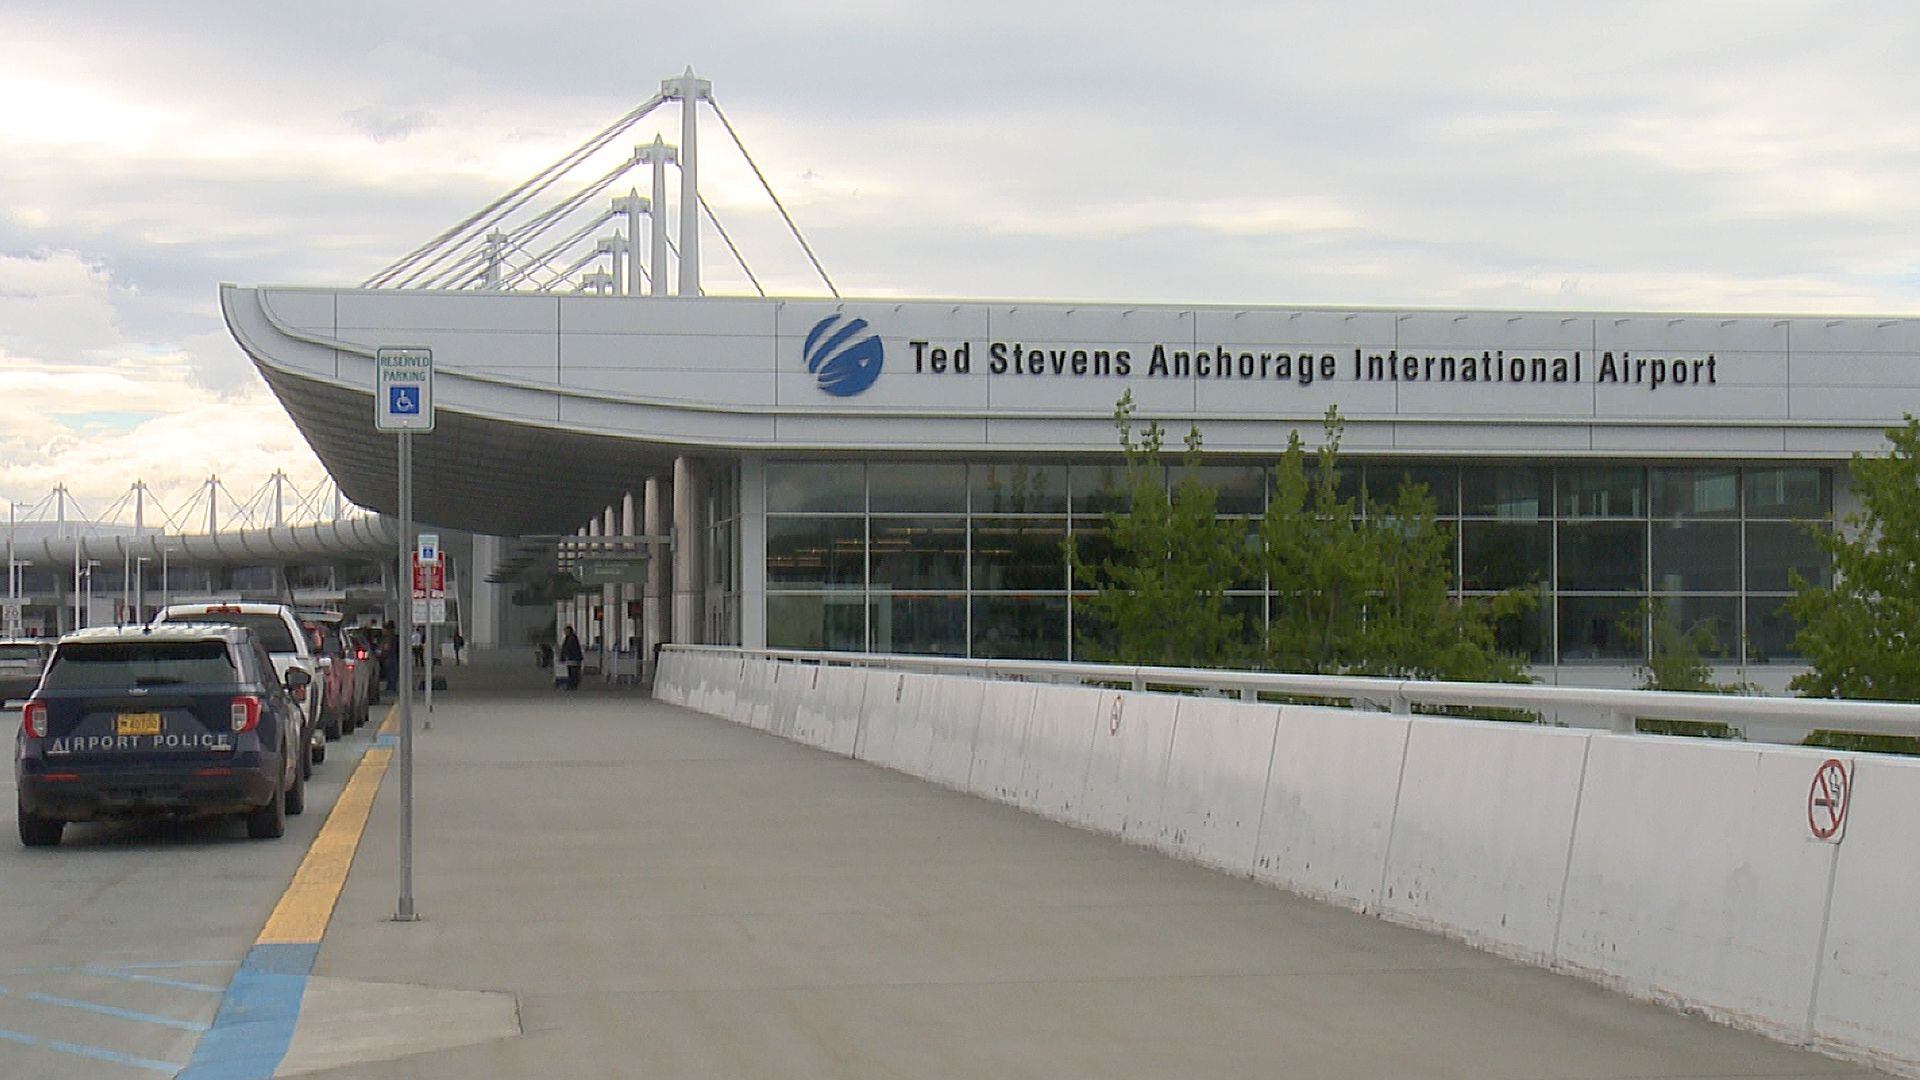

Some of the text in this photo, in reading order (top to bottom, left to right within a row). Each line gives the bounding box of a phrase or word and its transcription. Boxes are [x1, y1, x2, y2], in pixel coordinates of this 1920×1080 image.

[380, 356, 430, 367] RESERVED
[909, 340, 1718, 391] Ted Stevens Anchorage International Airport
[383, 370, 426, 382] PARKING
[51, 733, 229, 752] AIRPORT POLICE
